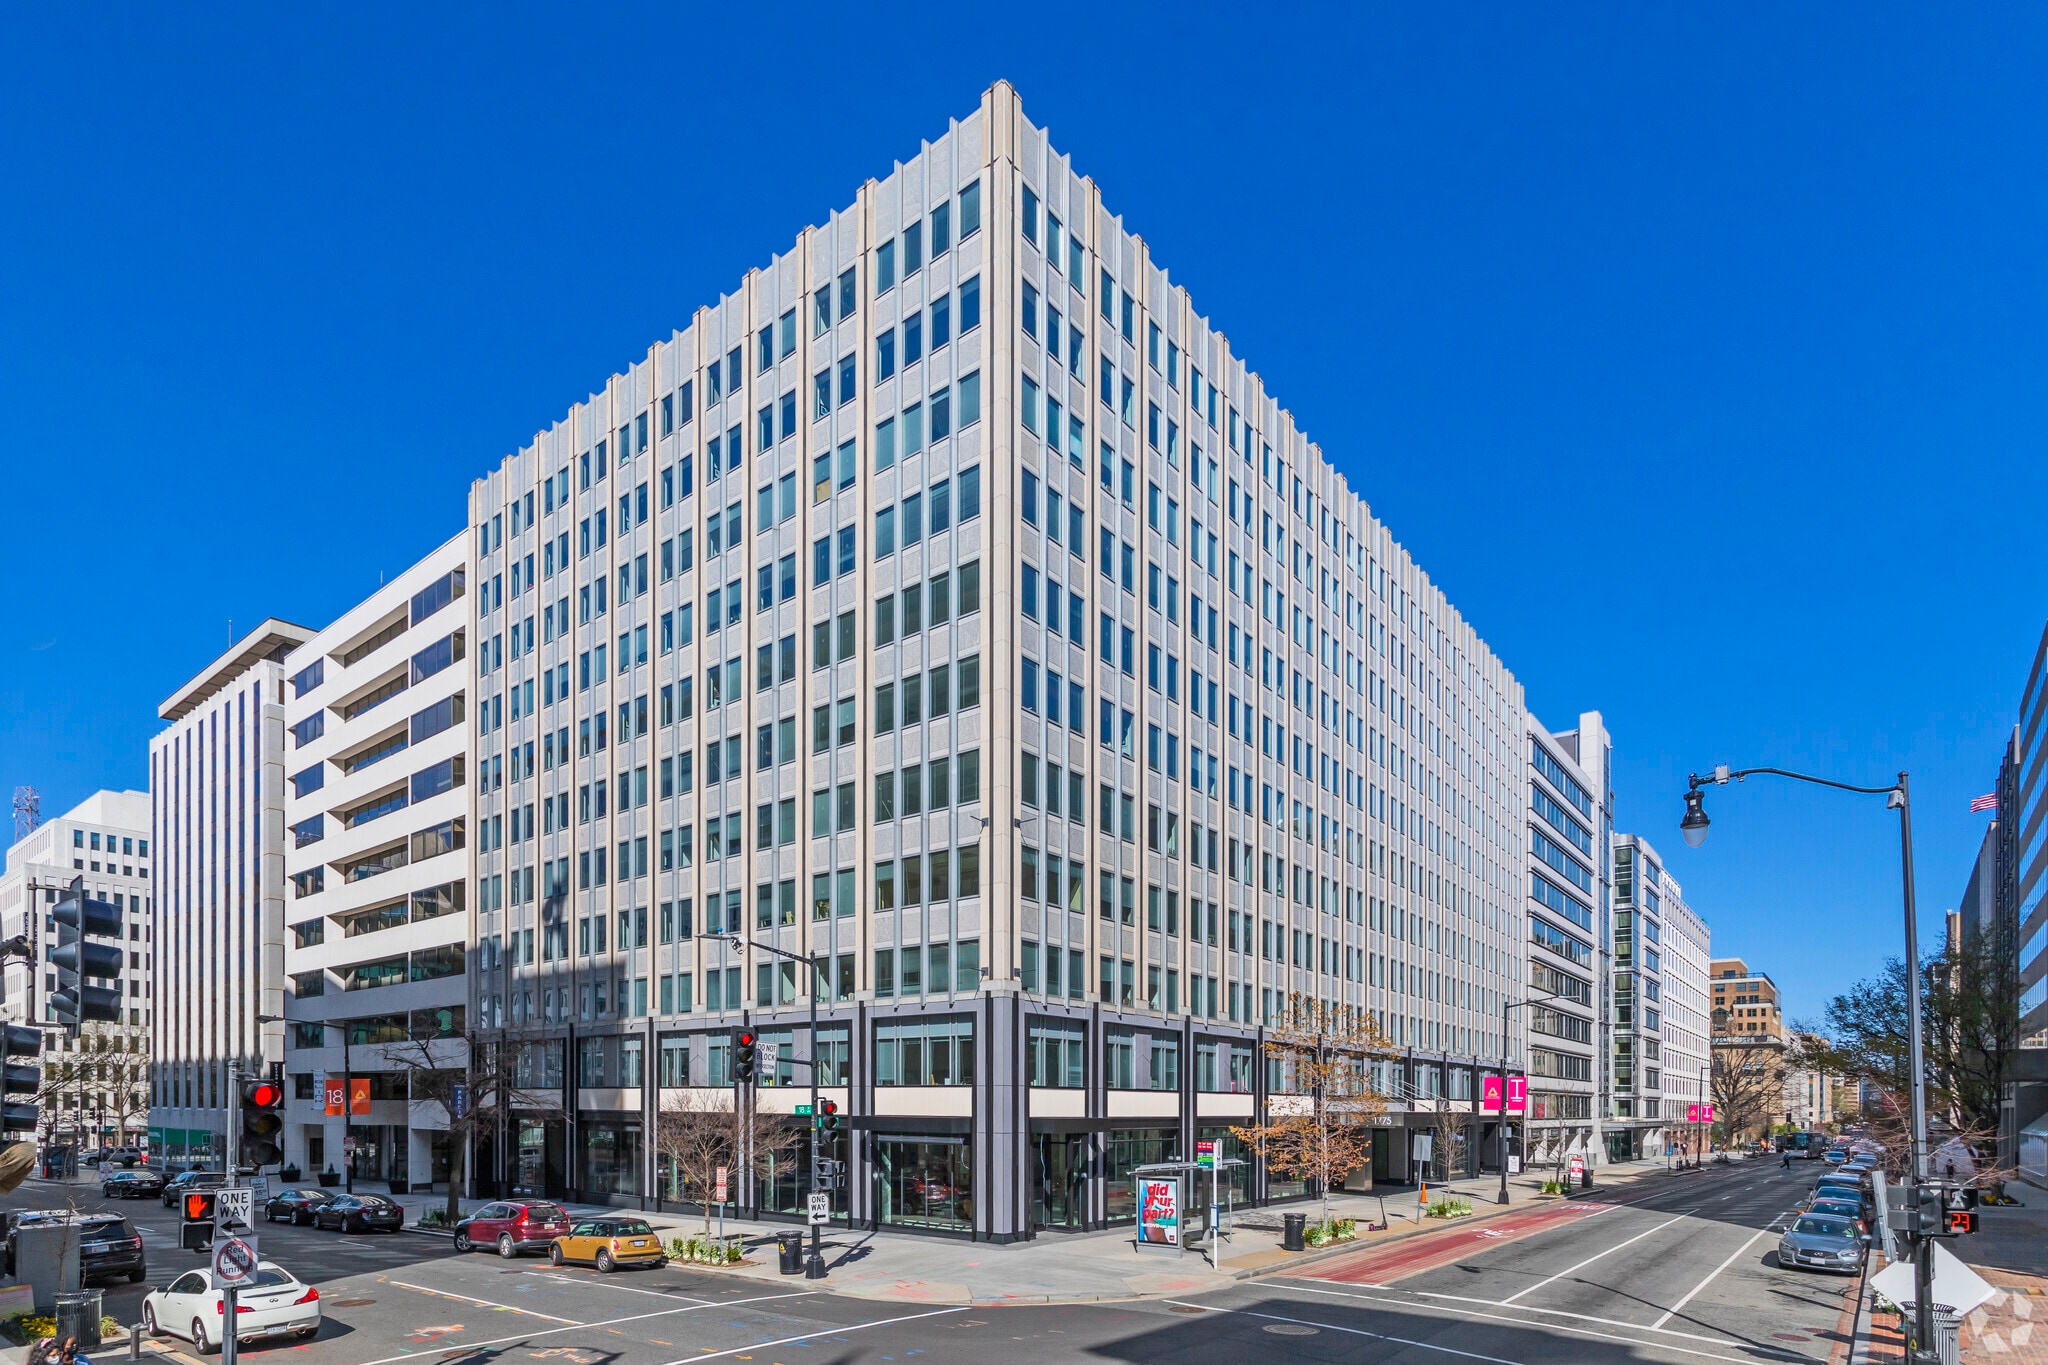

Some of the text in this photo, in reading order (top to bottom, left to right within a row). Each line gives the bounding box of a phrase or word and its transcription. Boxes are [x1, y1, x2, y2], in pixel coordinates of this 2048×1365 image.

[758, 1043, 765, 1051] DO
[756, 1052, 775, 1061] BLOCK
[1374, 1116, 1392, 1125] 1775
[1147, 1183, 1169, 1196] did
[220, 1192, 249, 1205] ONE
[1143, 1196, 1173, 1208] your
[219, 1205, 249, 1218] WAY
[811, 1203, 826, 1211] WAY
[1142, 1208, 1175, 1220] part?
[1951, 1213, 1970, 1231] 23
[226, 1244, 244, 1254] Red
[223, 1254, 247, 1265] Light
[216, 1264, 253, 1276] Running
